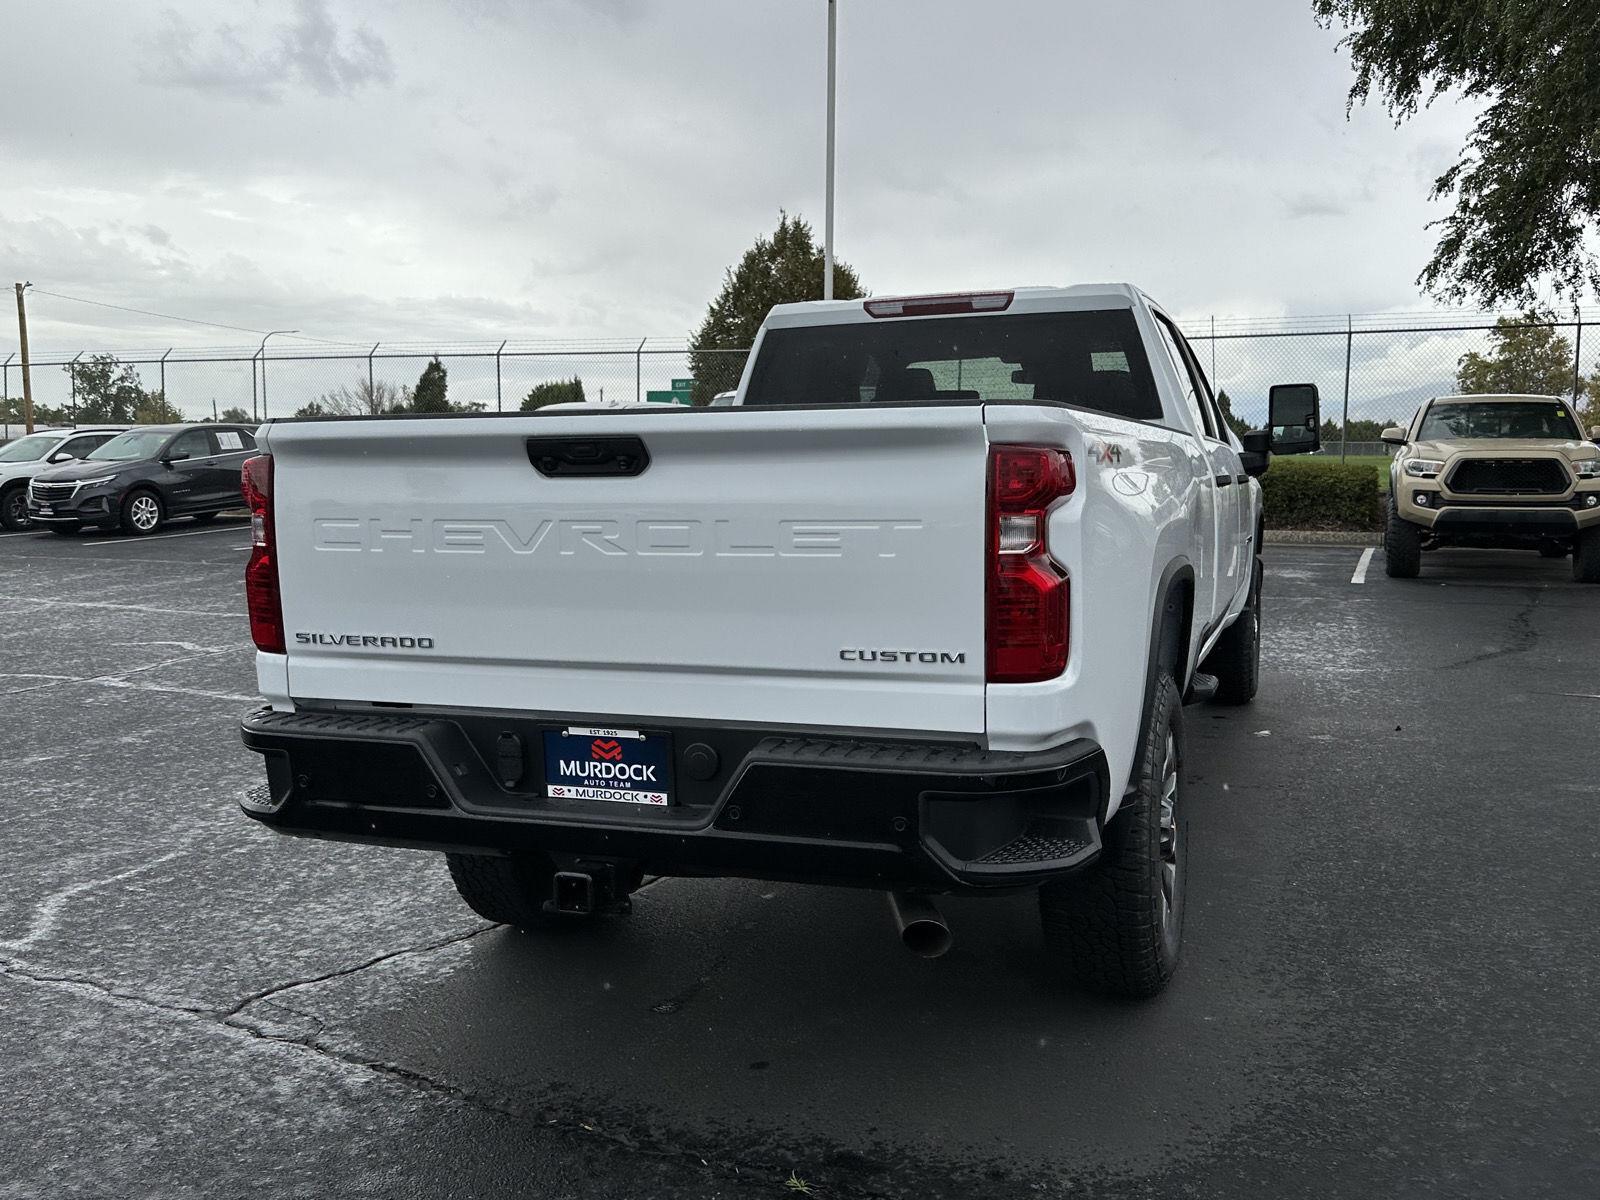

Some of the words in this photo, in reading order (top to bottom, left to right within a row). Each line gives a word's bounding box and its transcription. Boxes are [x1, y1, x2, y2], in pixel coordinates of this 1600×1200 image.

[313, 518, 923, 558] CHEVROLET
[295, 632, 434, 649] SILVERADO
[839, 649, 966, 664] CUSTOM
[559, 759, 657, 782] MURDOCK
[609, 780, 631, 788] TEAM
[575, 788, 640, 802] MURDOCK
